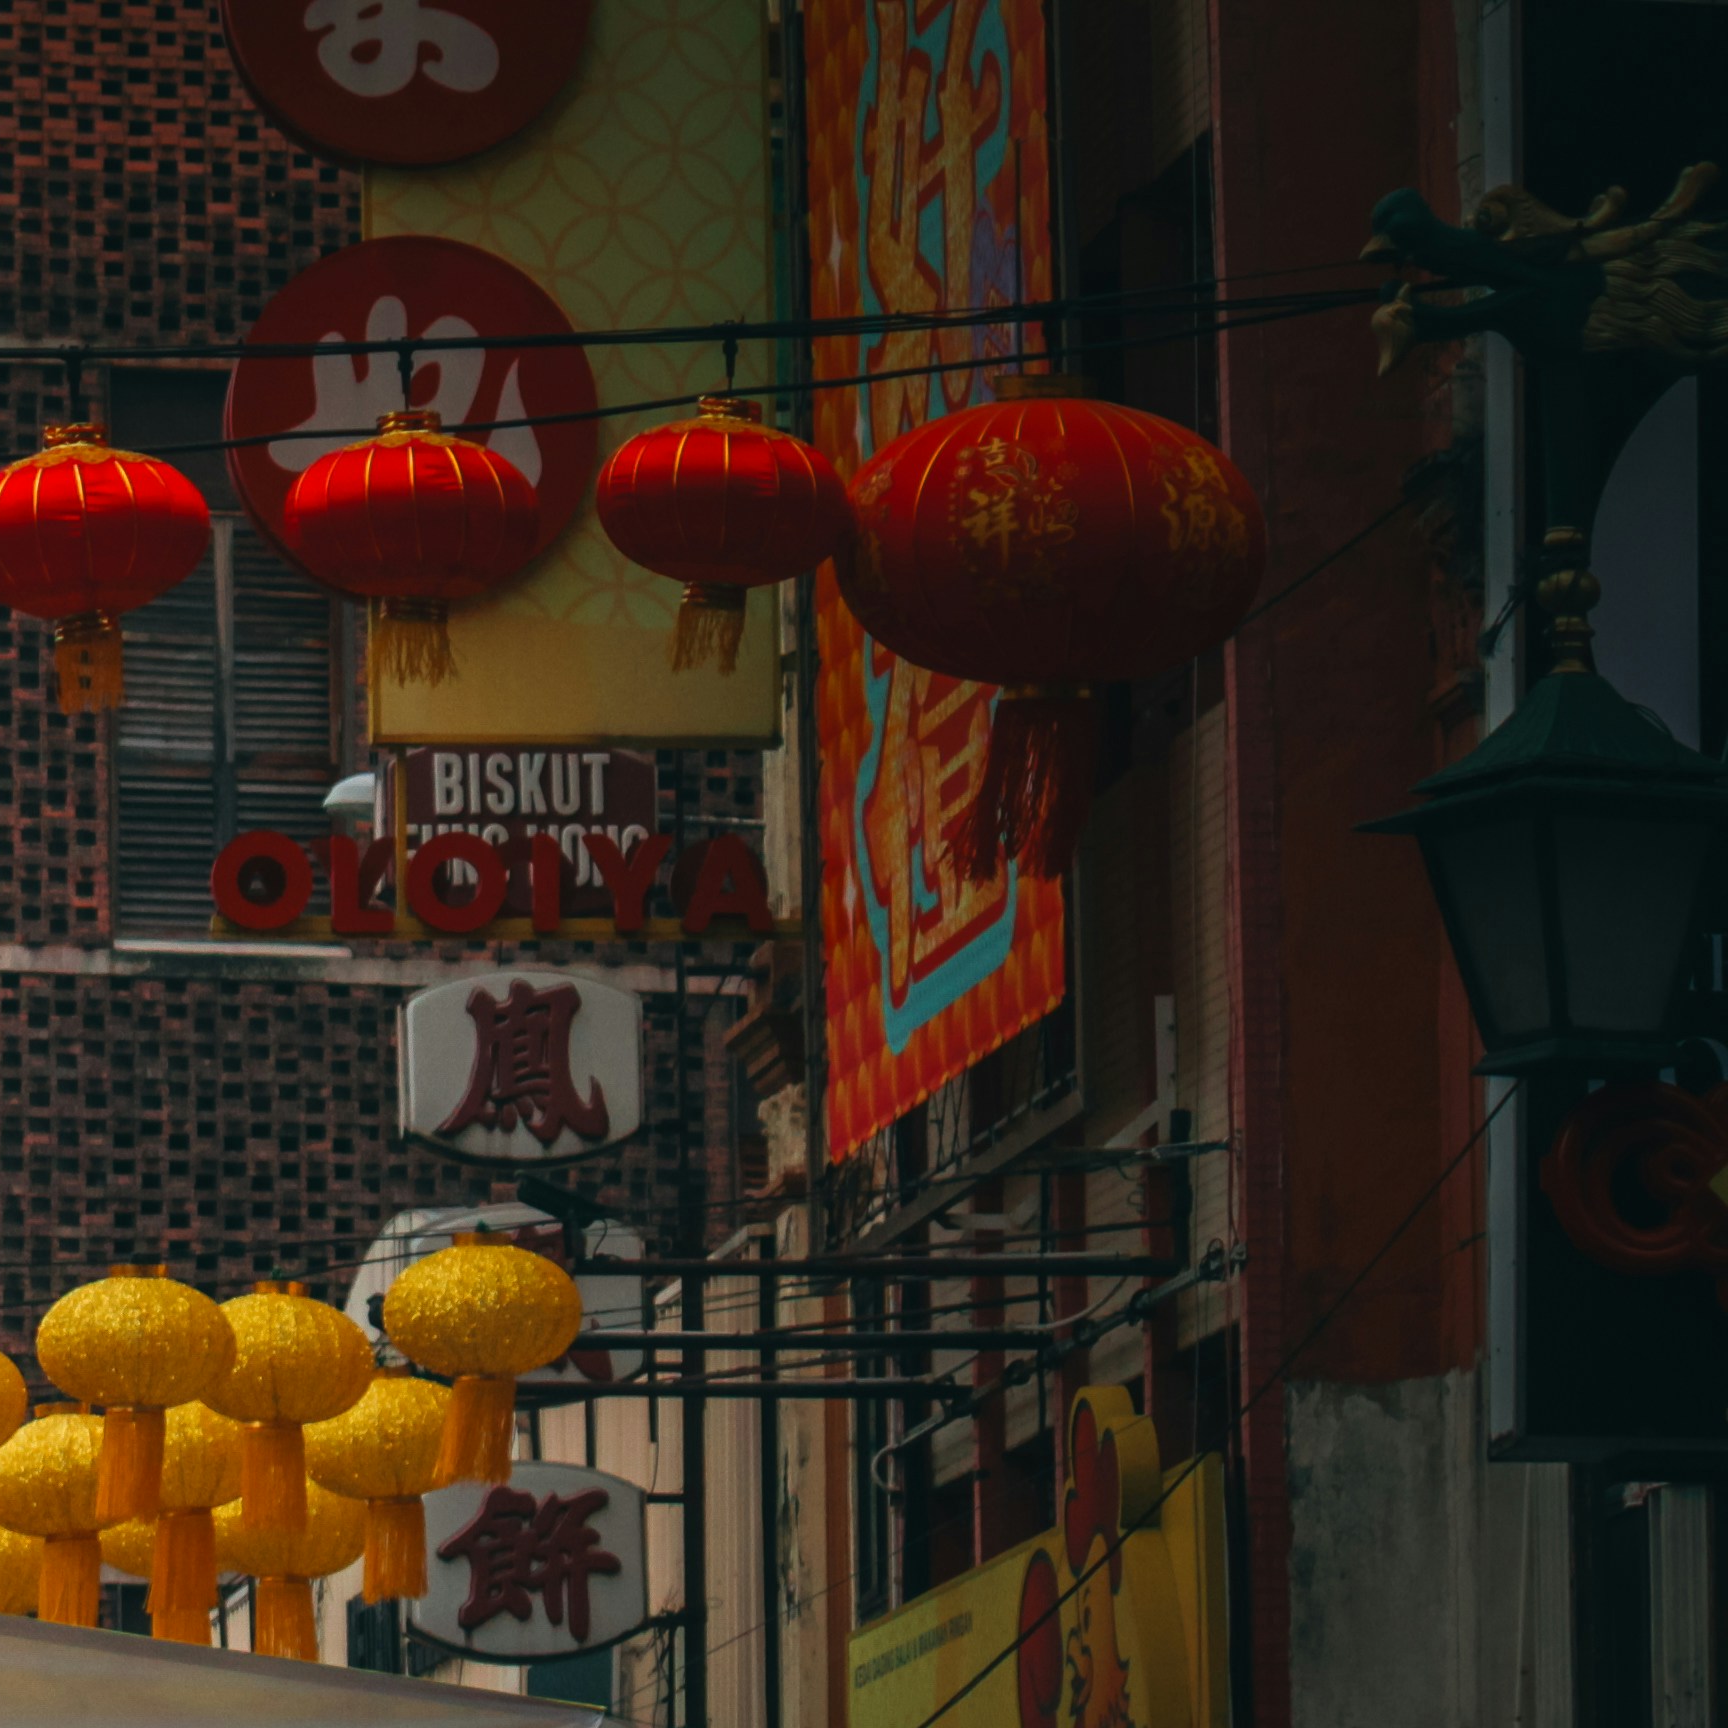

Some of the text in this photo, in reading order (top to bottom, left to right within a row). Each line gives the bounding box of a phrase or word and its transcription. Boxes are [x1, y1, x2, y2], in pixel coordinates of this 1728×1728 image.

[434, 752, 610, 816] BISKUT
[211, 829, 774, 934] OLOIYA
[437, 1485, 622, 1643] 餅
